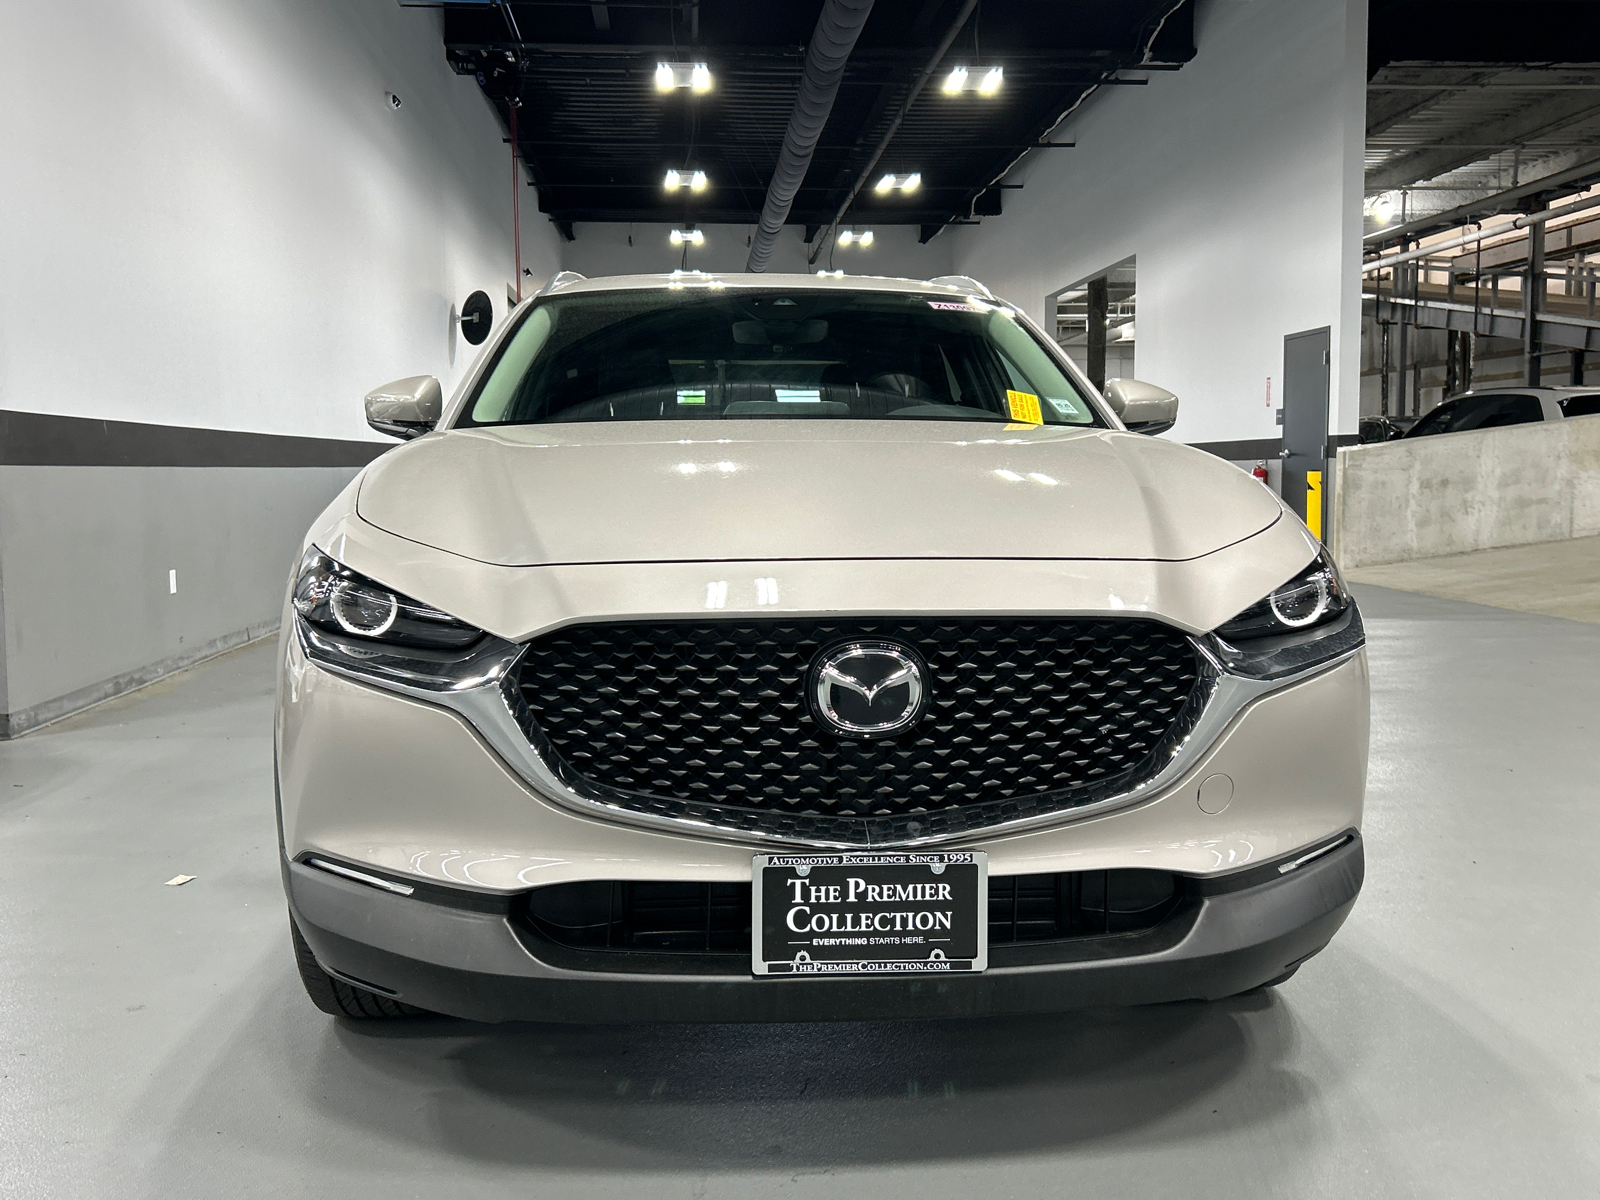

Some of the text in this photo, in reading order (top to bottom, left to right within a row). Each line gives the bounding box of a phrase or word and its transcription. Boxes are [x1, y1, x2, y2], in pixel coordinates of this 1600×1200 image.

[770, 853, 972, 865] AUTOMOTIVE EXCELLENCE SINCE 1995
[787, 878, 952, 903] THE PREMIER
[786, 905, 952, 933] COLLECTION
